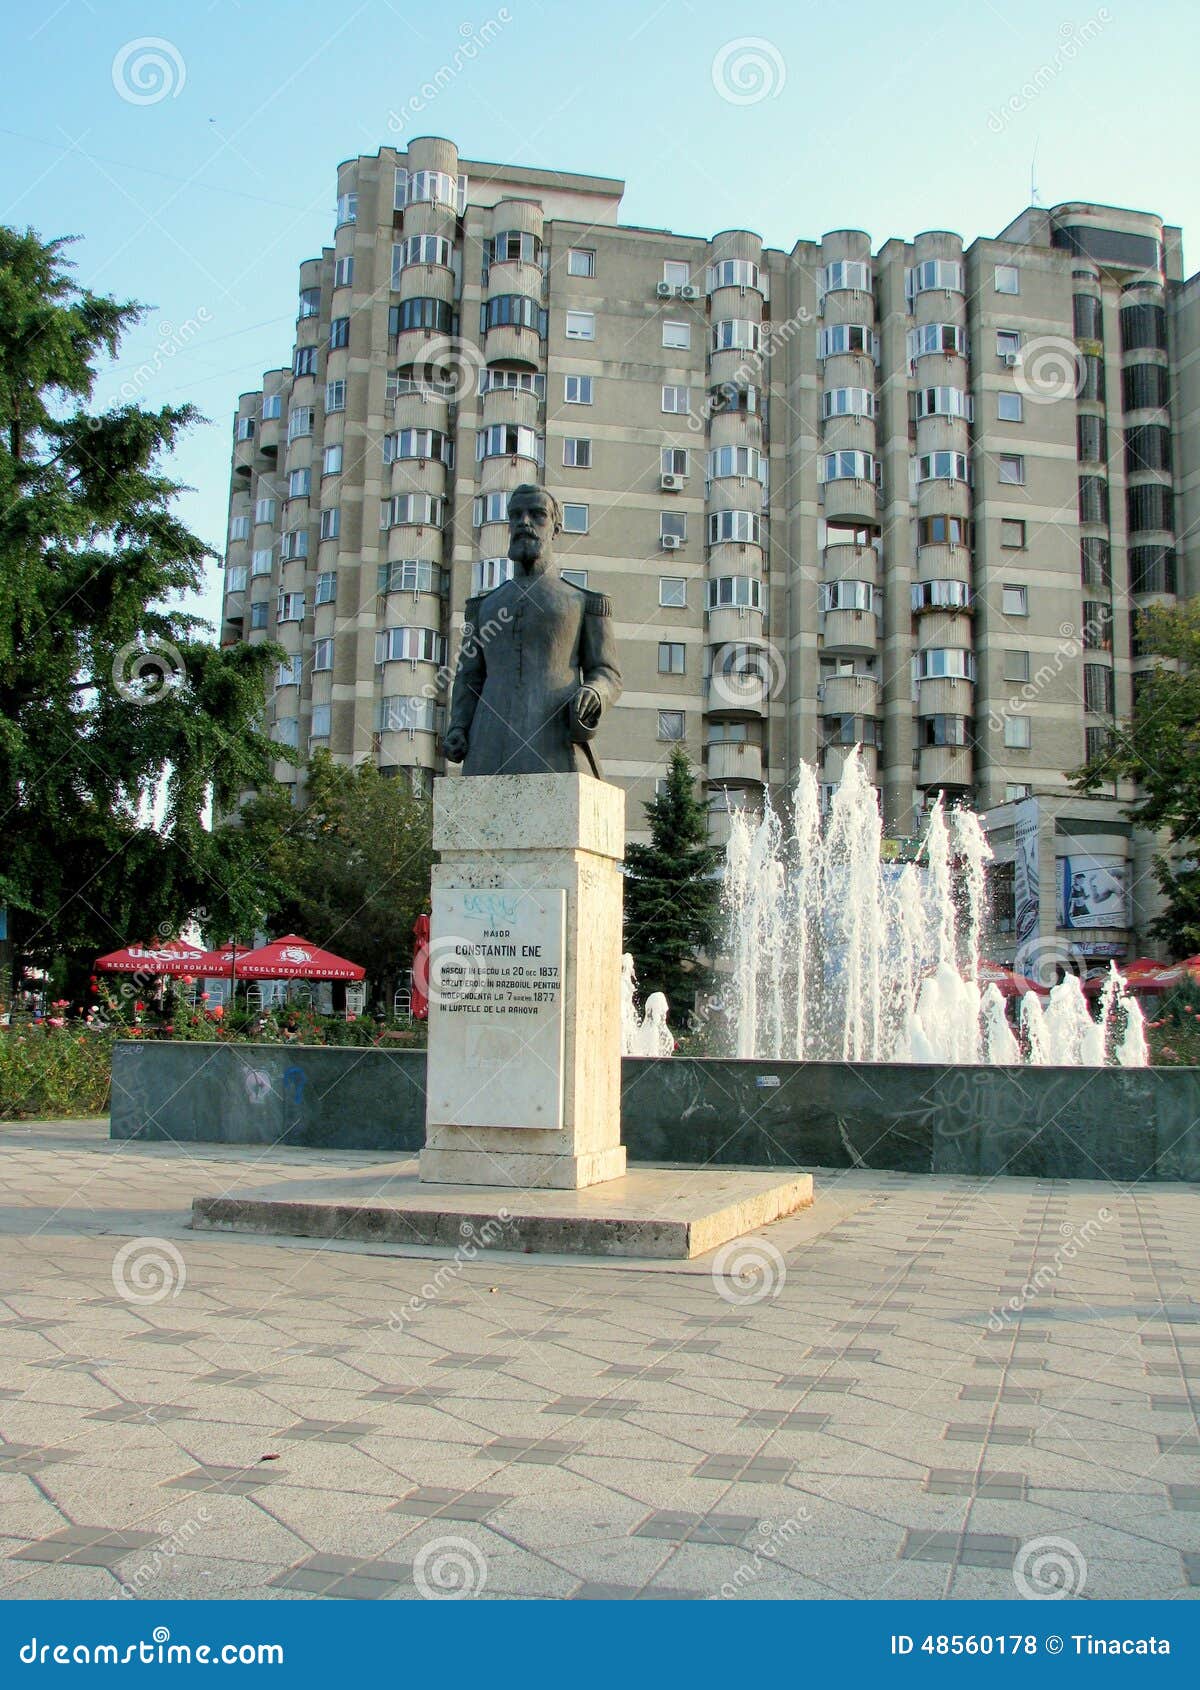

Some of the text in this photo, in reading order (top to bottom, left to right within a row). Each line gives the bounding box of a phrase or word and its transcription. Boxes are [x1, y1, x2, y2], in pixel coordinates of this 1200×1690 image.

[128, 948, 203, 961] URSUS
[455, 945, 543, 957] CONSTANTIN ENE
[107, 962, 142, 970] REGELE
[183, 964, 224, 972] ROMÂNIA
[242, 965, 276, 973] REGELE
[316, 968, 356, 977] ROMÂNIA
[501, 968, 511, 976] LA
[512, 966, 524, 976] 20
[494, 993, 504, 1001] LA
[506, 991, 513, 1001] 7
[533, 992, 555, 1002] 1877
[448, 1004, 481, 1013] LUPTELE
[483, 1005, 494, 1013] DE
[495, 1005, 506, 1014] LA
[508, 1006, 539, 1015] RAHOVA
